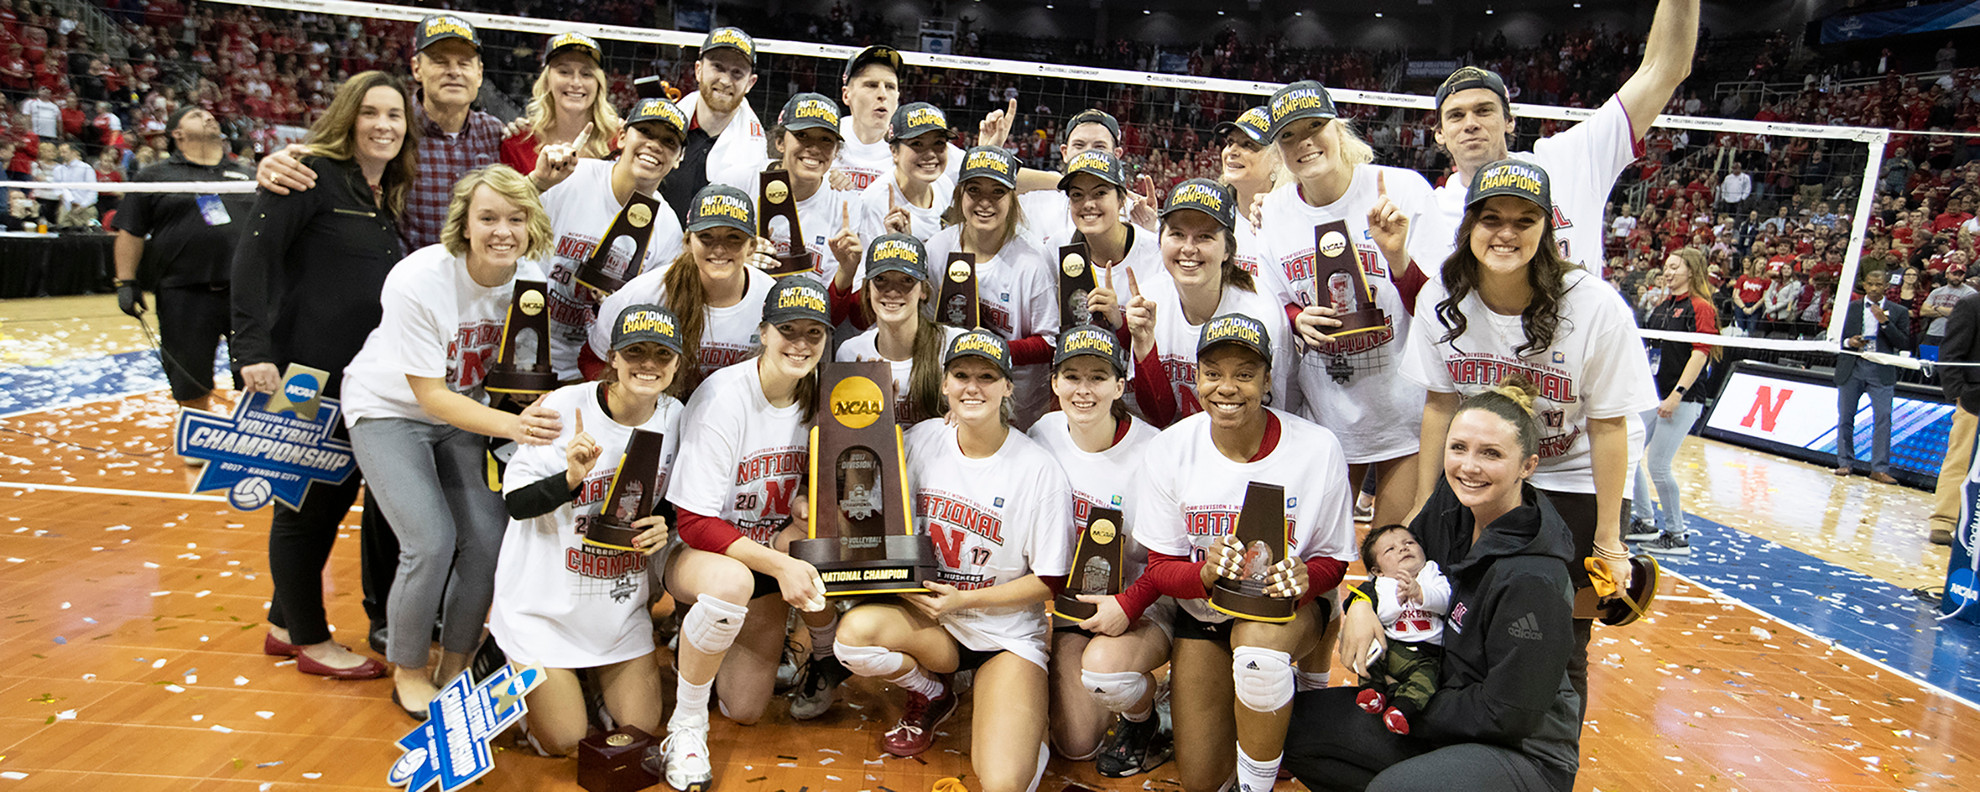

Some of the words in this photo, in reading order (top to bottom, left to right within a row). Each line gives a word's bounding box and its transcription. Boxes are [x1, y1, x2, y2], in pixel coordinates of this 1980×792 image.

[1273, 96, 1321, 123] CHAMPIONS
[966, 157, 1009, 175] CHAMPIONS
[1480, 174, 1542, 195] CHAMPIONS
[1172, 191, 1222, 211] CHAMPIONS
[700, 204, 749, 222] CHAMPIONS
[873, 248, 919, 265] CHAMPIONS
[778, 295, 826, 313] CHAMPIONS
[623, 319, 675, 338] CHAMPIONS
[1206, 325, 1260, 344] CHAMPIONS
[955, 340, 1003, 360] CHAMPIONS
[1064, 338, 1113, 356] CHAMPIONS
[1530, 362, 1572, 378] VOLLEYBALL
[286, 385, 316, 398] NCAA
[833, 400, 884, 416] NCAA
[1740, 385, 1794, 433] N
[247, 410, 284, 424] DIVISION
[288, 418, 324, 432] WOMEN'S
[1542, 408, 1565, 428] 17
[236, 418, 323, 447] VOLLEYBALL
[188, 426, 351, 472] CHAMPIONSHIP
[220, 462, 243, 472] 2017
[247, 466, 280, 479] KANSAS
[280, 473, 302, 482] CITY
[841, 461, 871, 469] DIVISION
[733, 491, 758, 511] 20
[760, 475, 800, 518] N
[848, 535, 882, 544] VOLLEYBALL
[929, 521, 968, 571] N
[970, 546, 992, 567] 17
[821, 569, 862, 583] NATIONAL
[863, 568, 909, 581] CHAMPION
[944, 573, 981, 582] HUSKERS
[1950, 582, 1978, 601] NCAA
[1507, 625, 1544, 640] adidas
